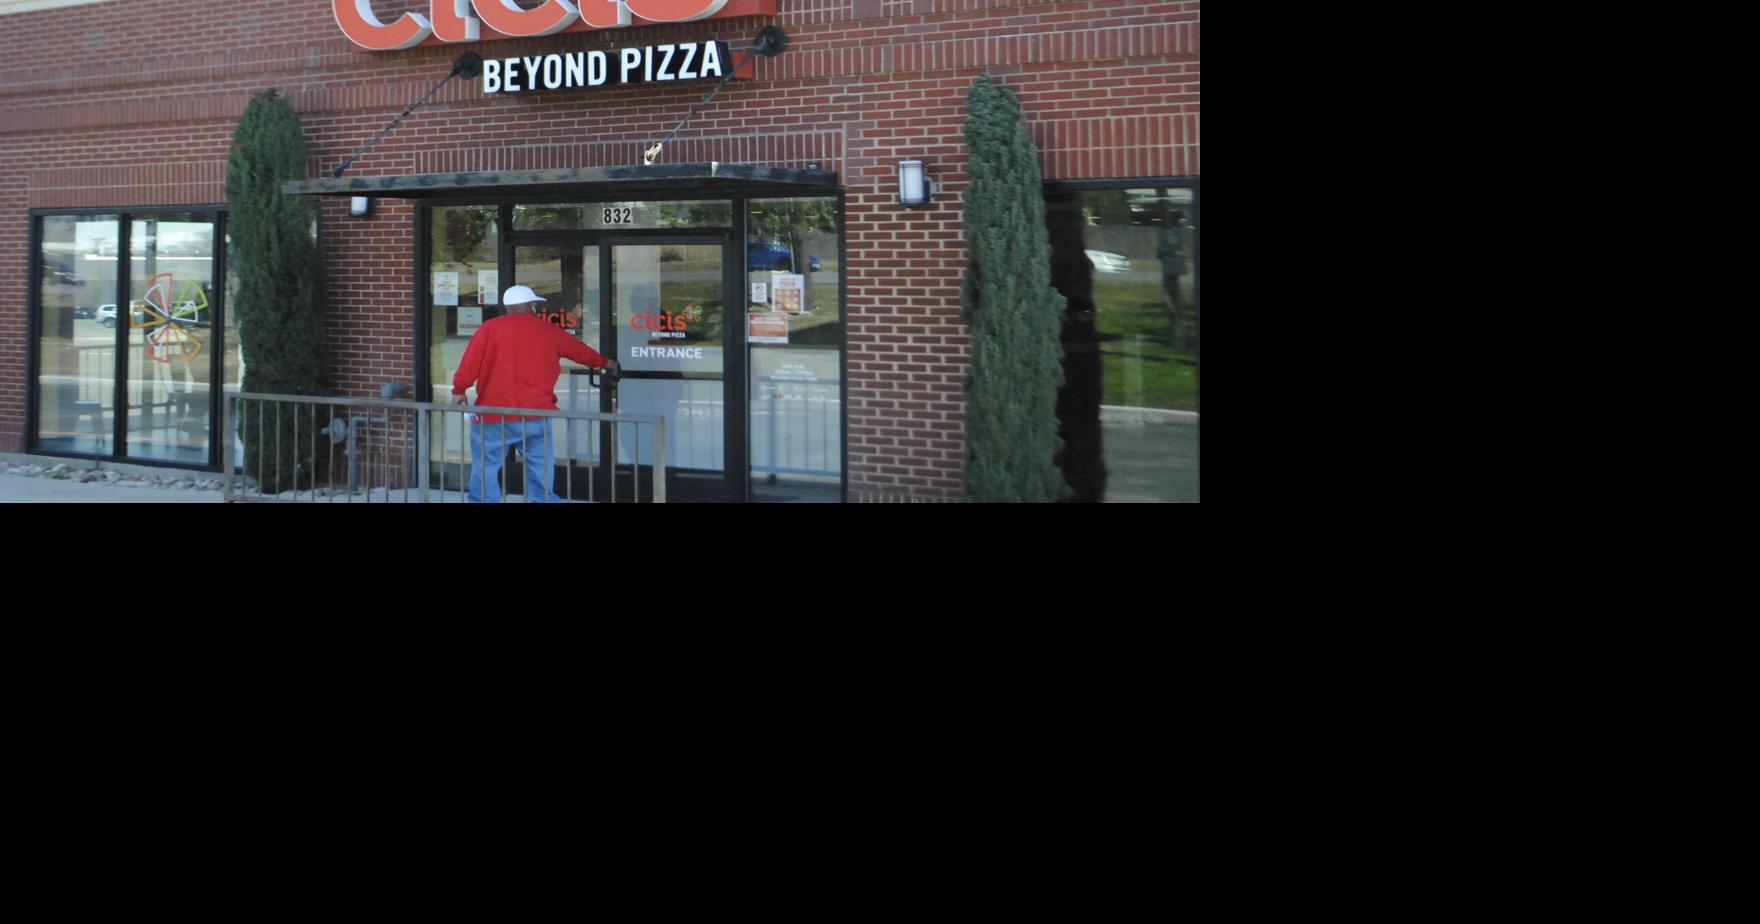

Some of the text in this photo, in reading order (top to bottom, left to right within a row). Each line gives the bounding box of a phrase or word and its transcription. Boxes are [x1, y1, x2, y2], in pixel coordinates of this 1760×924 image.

[483, 40, 723, 94] BEYOND PIZZA
[604, 208, 631, 224] 832
[537, 307, 577, 328] icis
[629, 310, 688, 331] cicis
[631, 346, 703, 359] ENTRANCE
